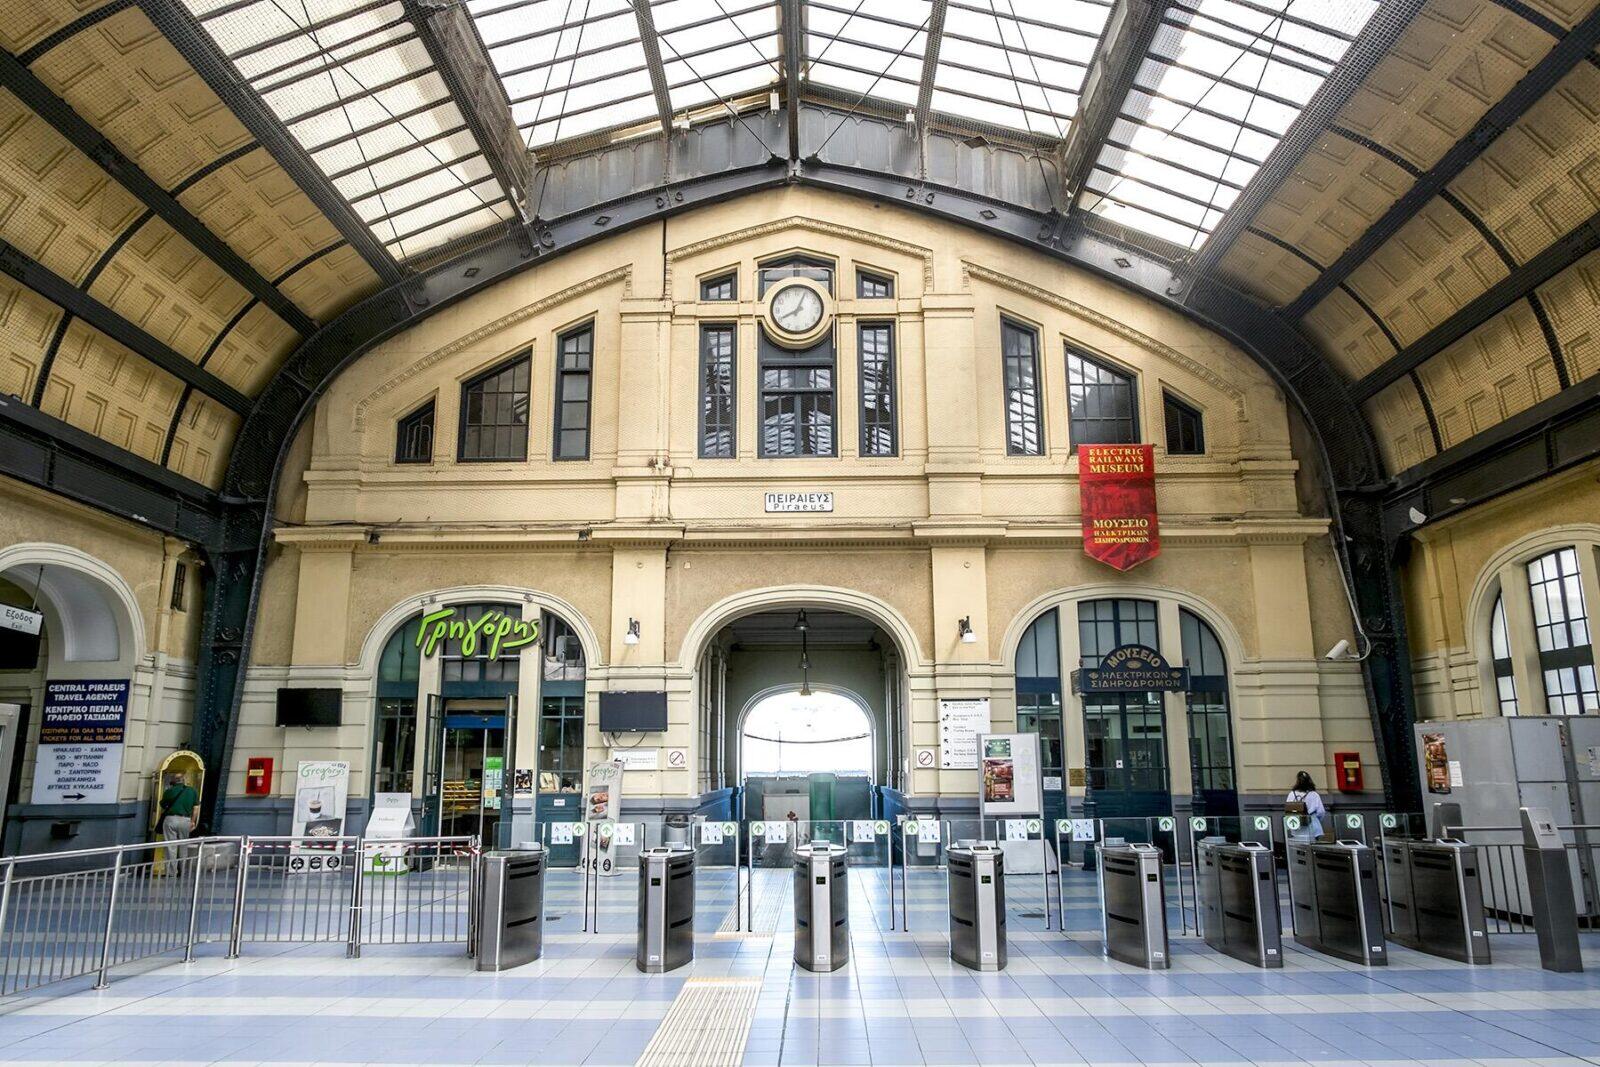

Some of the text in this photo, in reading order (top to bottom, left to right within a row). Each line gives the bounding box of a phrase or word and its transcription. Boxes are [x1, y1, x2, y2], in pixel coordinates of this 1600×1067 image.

[1089, 448, 1144, 456] ELECTRIC
[1090, 464, 1144, 473] MUSEUM
[768, 494, 830, 503] ΠΕΙΡΑΙΕΥΣ
[1093, 519, 1149, 529] ΜΟΥΣΕΙΟ
[415, 608, 540, 660] Γρηγόρης
[1107, 647, 1161, 668] ΜΟΥΣΕΙΟ
[1101, 671, 1169, 679] ΗΛΕΚΤΡΙΚΩΝ
[48, 683, 126, 692] CENTRAL PIRAEUS
[1091, 679, 1181, 688] ΣΙΔΗΡΟΔΡΟΜΩΝ
[54, 693, 118, 701] TRAVEL AGENCY
[45, 705, 124, 714] ΚΕΝΤΡΙΚΟ ΠΕΙΡΑΙΑ
